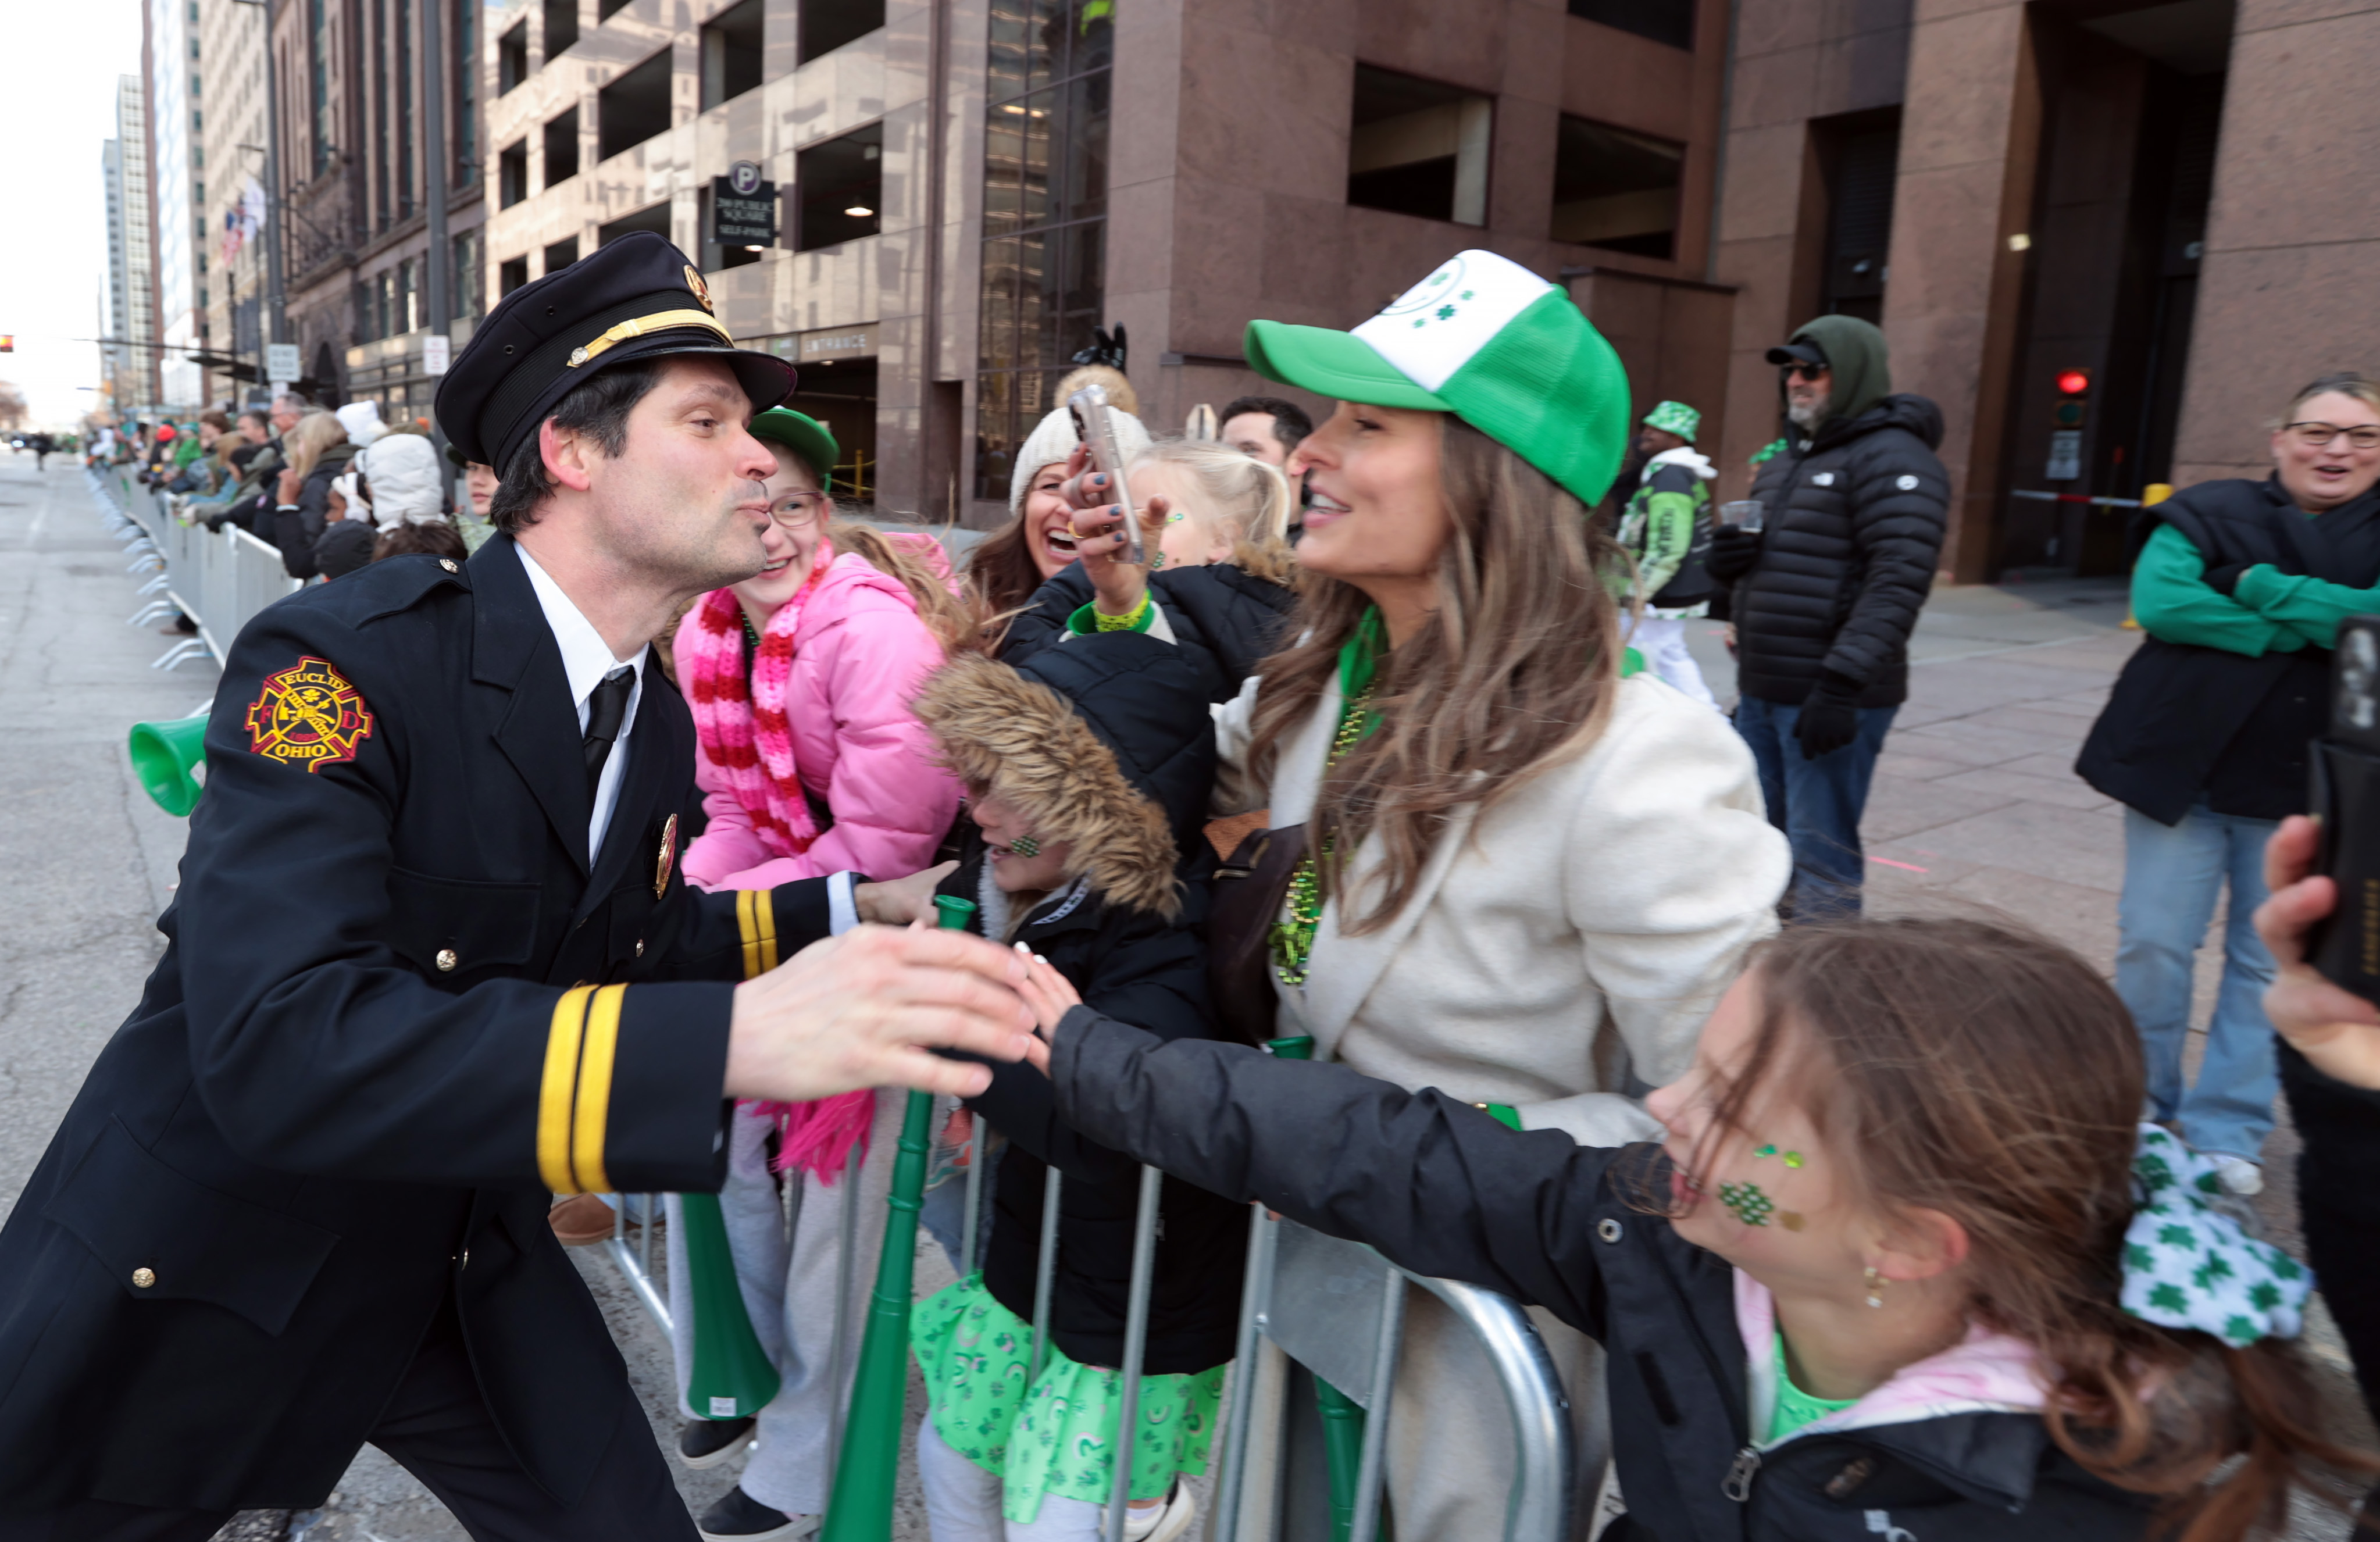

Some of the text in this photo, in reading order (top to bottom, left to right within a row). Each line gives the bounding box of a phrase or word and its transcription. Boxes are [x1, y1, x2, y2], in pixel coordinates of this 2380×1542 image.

[738, 166, 754, 188] P
[734, 199, 774, 212] PUBLIC
[722, 208, 766, 222] SQUARE
[718, 224, 770, 237] SELF-PARK
[805, 334, 866, 353] ENTRANCE
[284, 673, 345, 690] EUCLID
[259, 705, 361, 729] F D
[274, 743, 328, 758] OHIO
